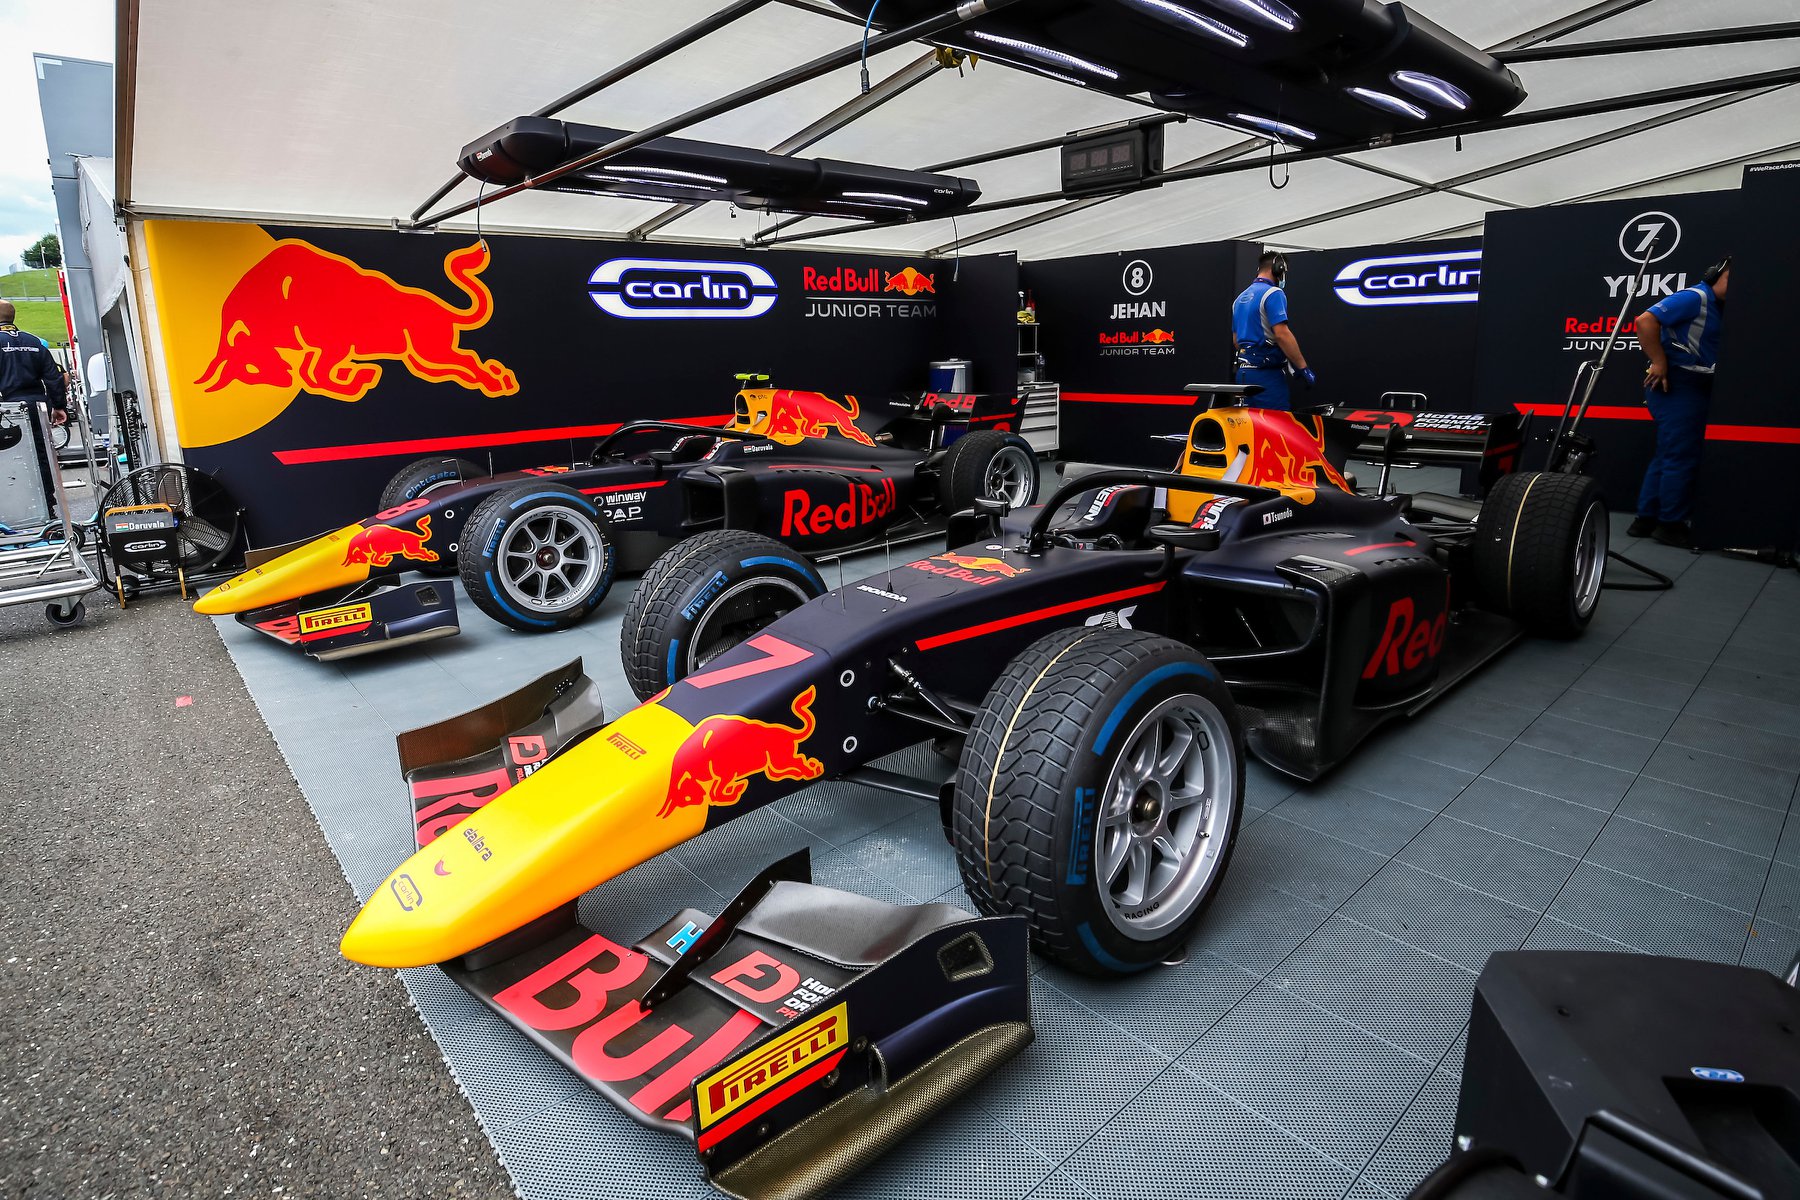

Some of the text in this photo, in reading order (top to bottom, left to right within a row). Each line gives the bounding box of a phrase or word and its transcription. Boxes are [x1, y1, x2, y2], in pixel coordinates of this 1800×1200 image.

[1633, 222, 1666, 253] 7
[624, 274, 748, 300] carlin
[803, 266, 879, 292] Red Bull
[1131, 267, 1144, 288] 8
[1603, 272, 1687, 298] YUKI
[805, 303, 937, 318] JUNIOR TEAM
[1110, 300, 1166, 320] JEHAN
[1565, 316, 1603, 333] Red
[1099, 330, 1139, 344] Red Bull
[1099, 347, 1175, 356] JUNIOR TEAM
[1413, 422, 1480, 431] DREAM
[1416, 412, 1485, 421] Honda
[375, 497, 431, 521] 8
[605, 491, 647, 503] winway
[780, 477, 896, 537] Red Bull
[129, 520, 165, 531] Daruvala
[1270, 507, 1293, 523] Tsunoda
[906, 560, 1003, 587] Red Bull
[304, 606, 366, 630] PIRELLI
[683, 633, 815, 689] 7
[606, 731, 647, 761] PIRELLI
[463, 827, 493, 862] dallara
[1065, 785, 1097, 886] PIRELLI
[1124, 901, 1160, 921] RACING
[708, 1014, 838, 1114] PIRELLI
